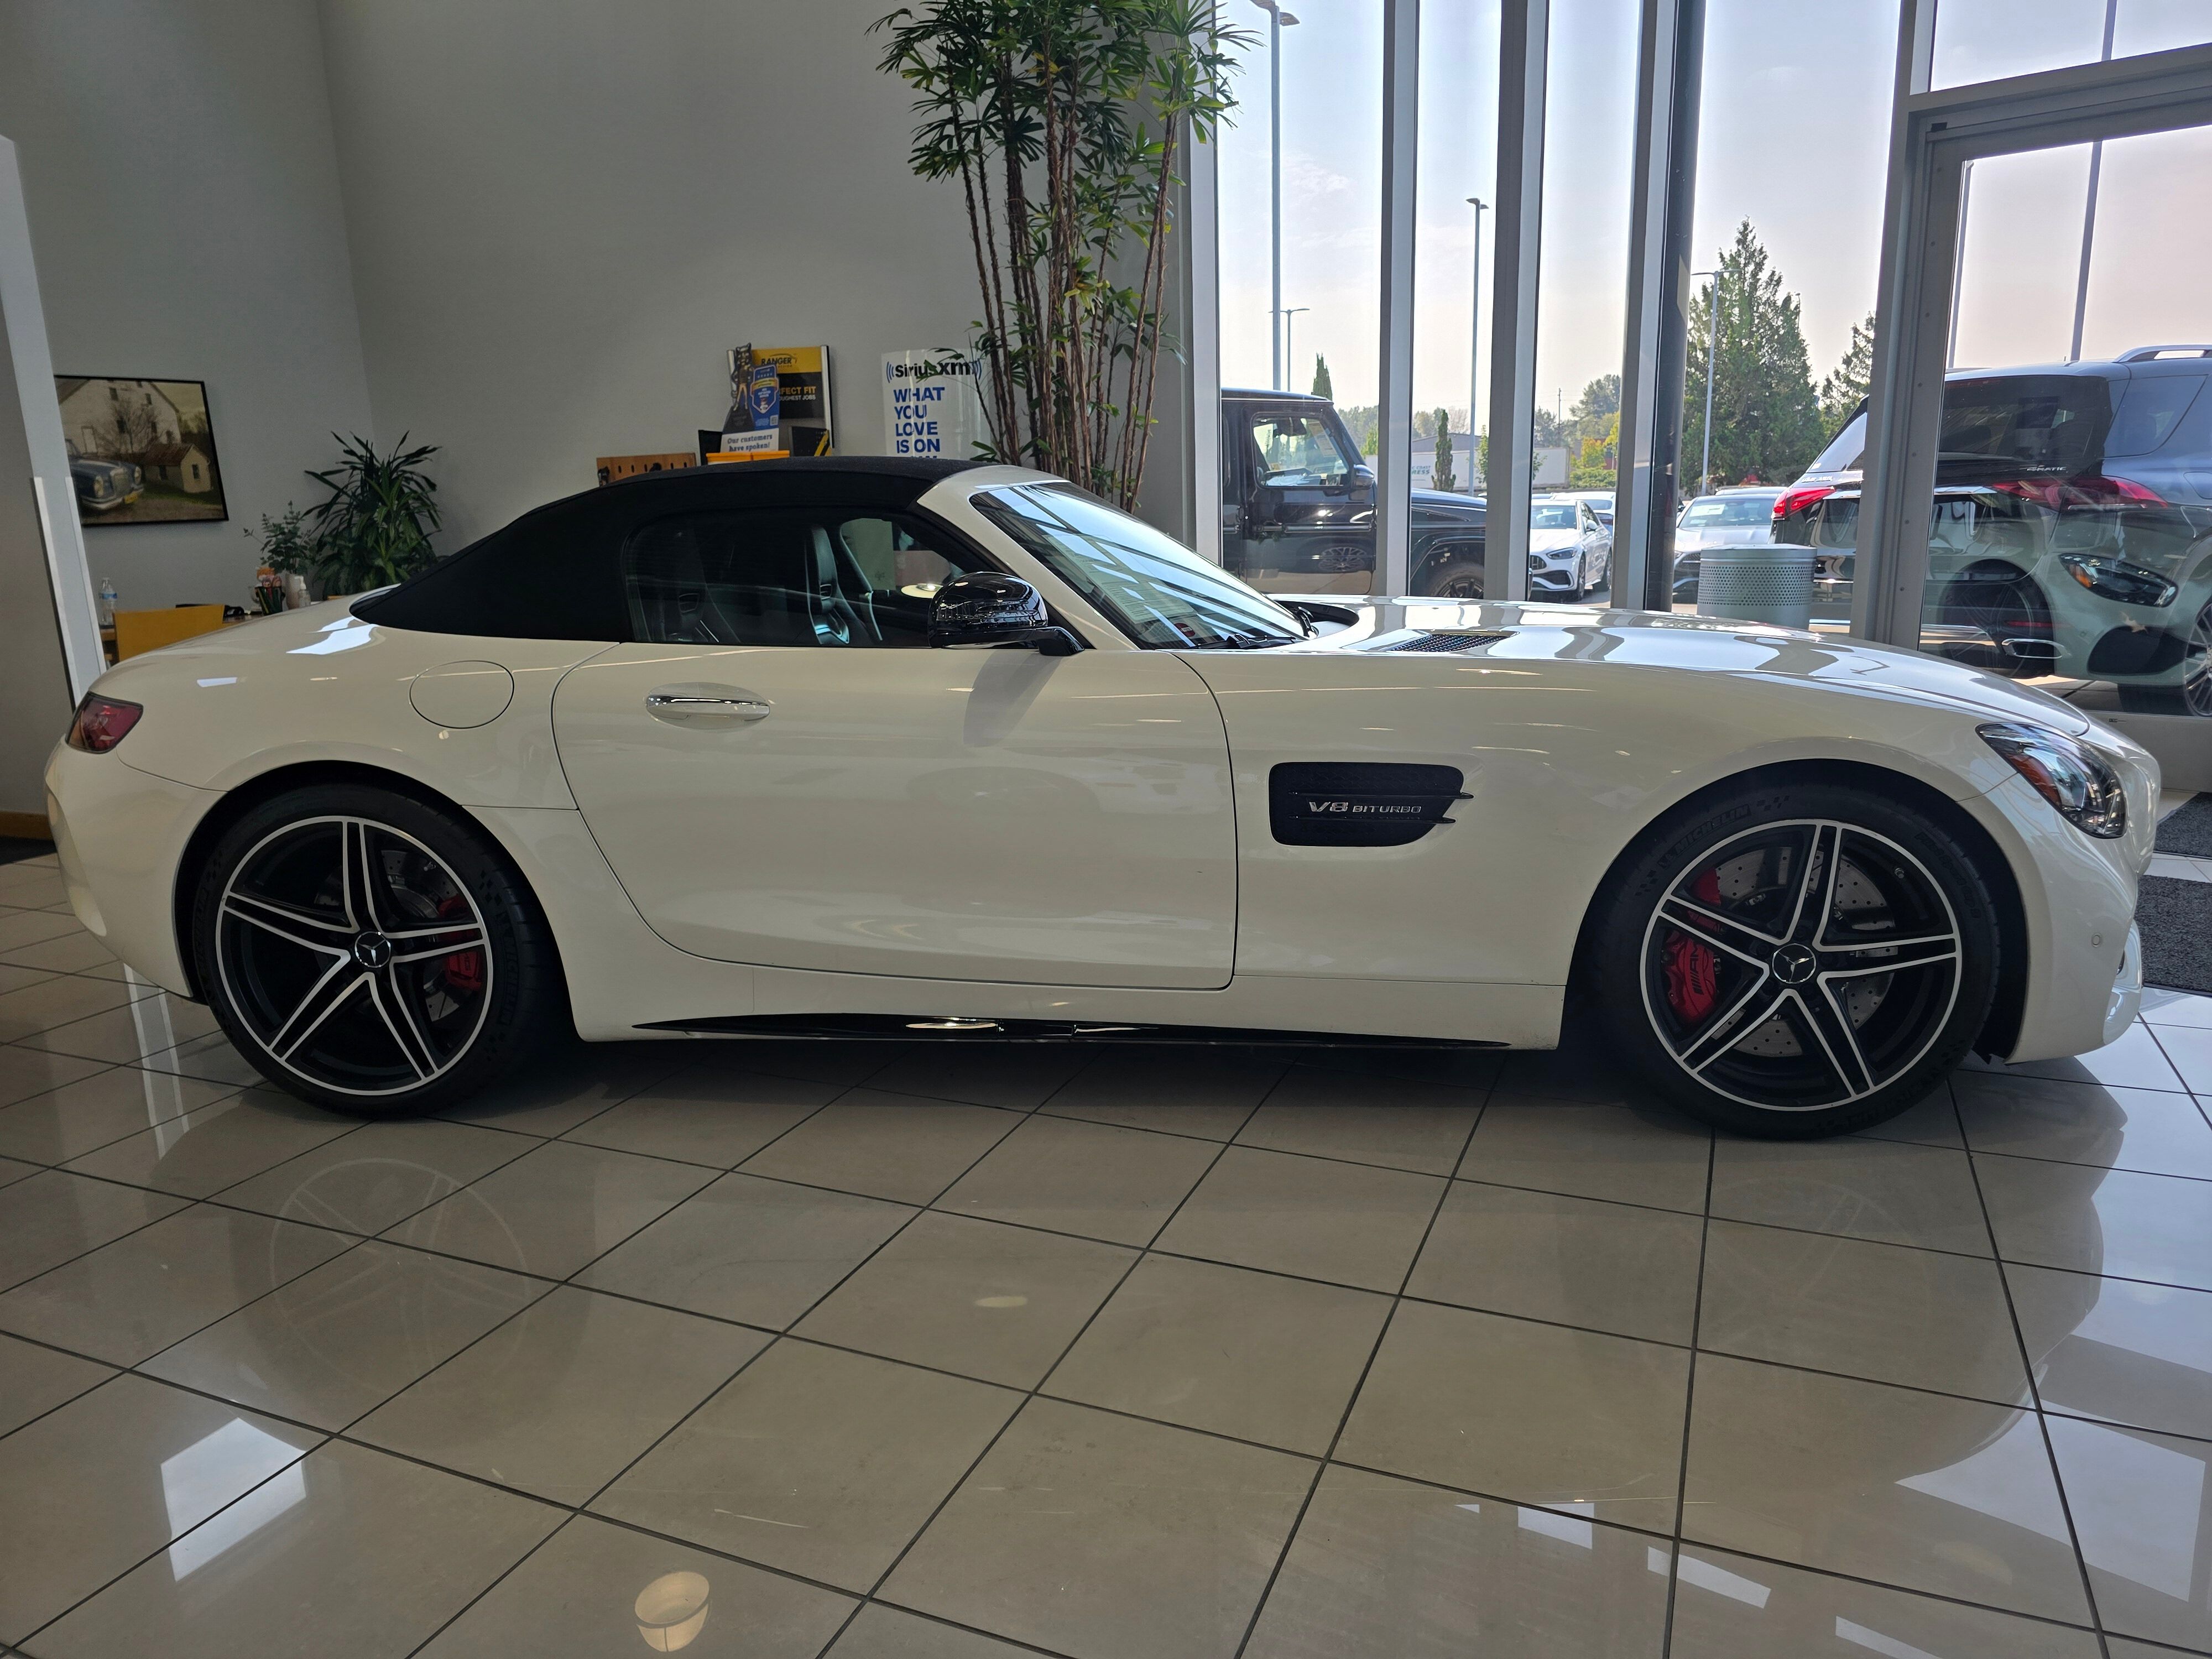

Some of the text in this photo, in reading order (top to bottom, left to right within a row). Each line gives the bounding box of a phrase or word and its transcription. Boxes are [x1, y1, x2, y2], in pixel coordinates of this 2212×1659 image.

[779, 387, 801, 395] FECT
[804, 386, 816, 394] FIT
[893, 387, 945, 403] WHAT
[894, 404, 927, 420] YOU
[895, 421, 938, 436] LOVE
[741, 434, 773, 443] customers
[746, 442, 770, 452] spoken!
[896, 439, 941, 453] IS ON
[1309, 802, 1422, 813] V8 BITURBO
[1671, 805, 1751, 854] MICHELIN
